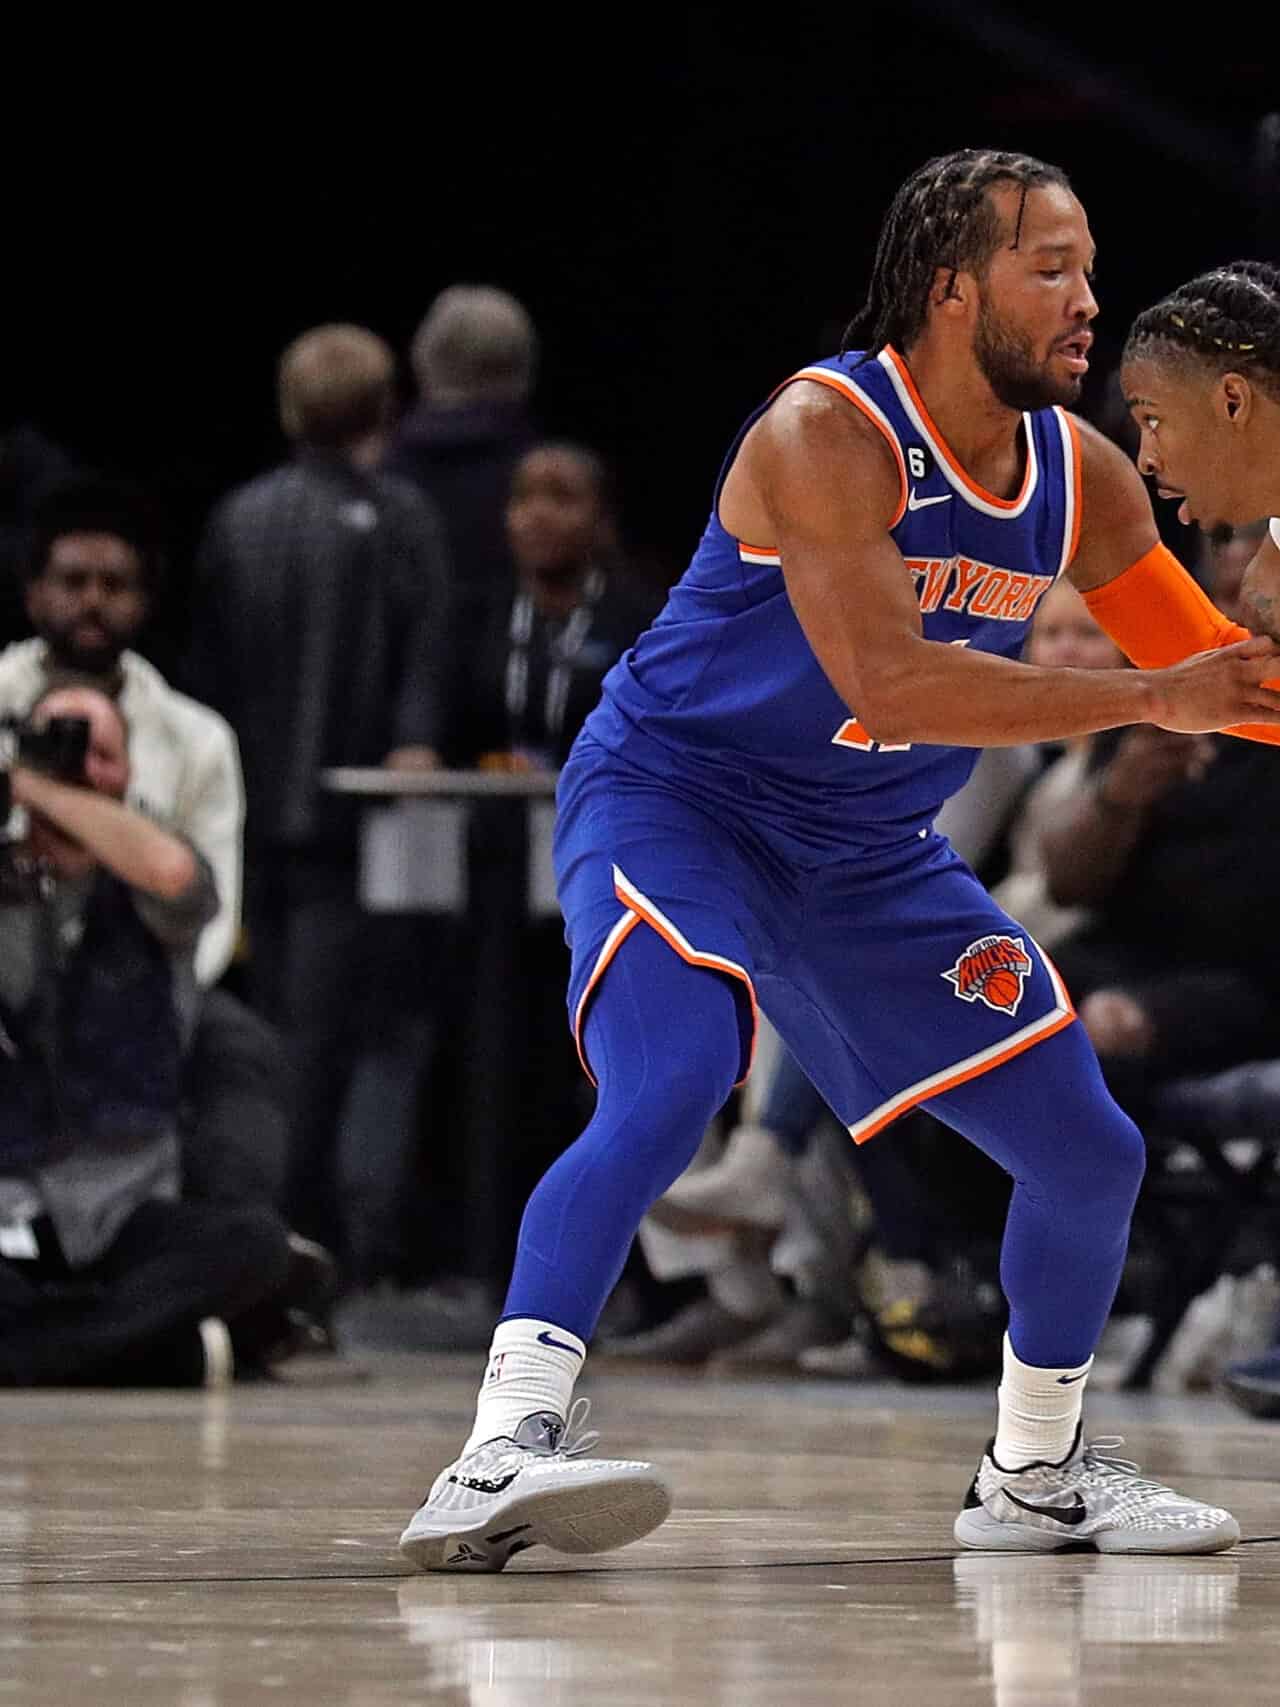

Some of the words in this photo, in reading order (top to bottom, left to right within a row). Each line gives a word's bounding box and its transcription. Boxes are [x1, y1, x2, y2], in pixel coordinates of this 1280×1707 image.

[908, 447, 925, 478] 6
[943, 553, 1055, 622] YORK
[958, 938, 1030, 993] KNICKS
